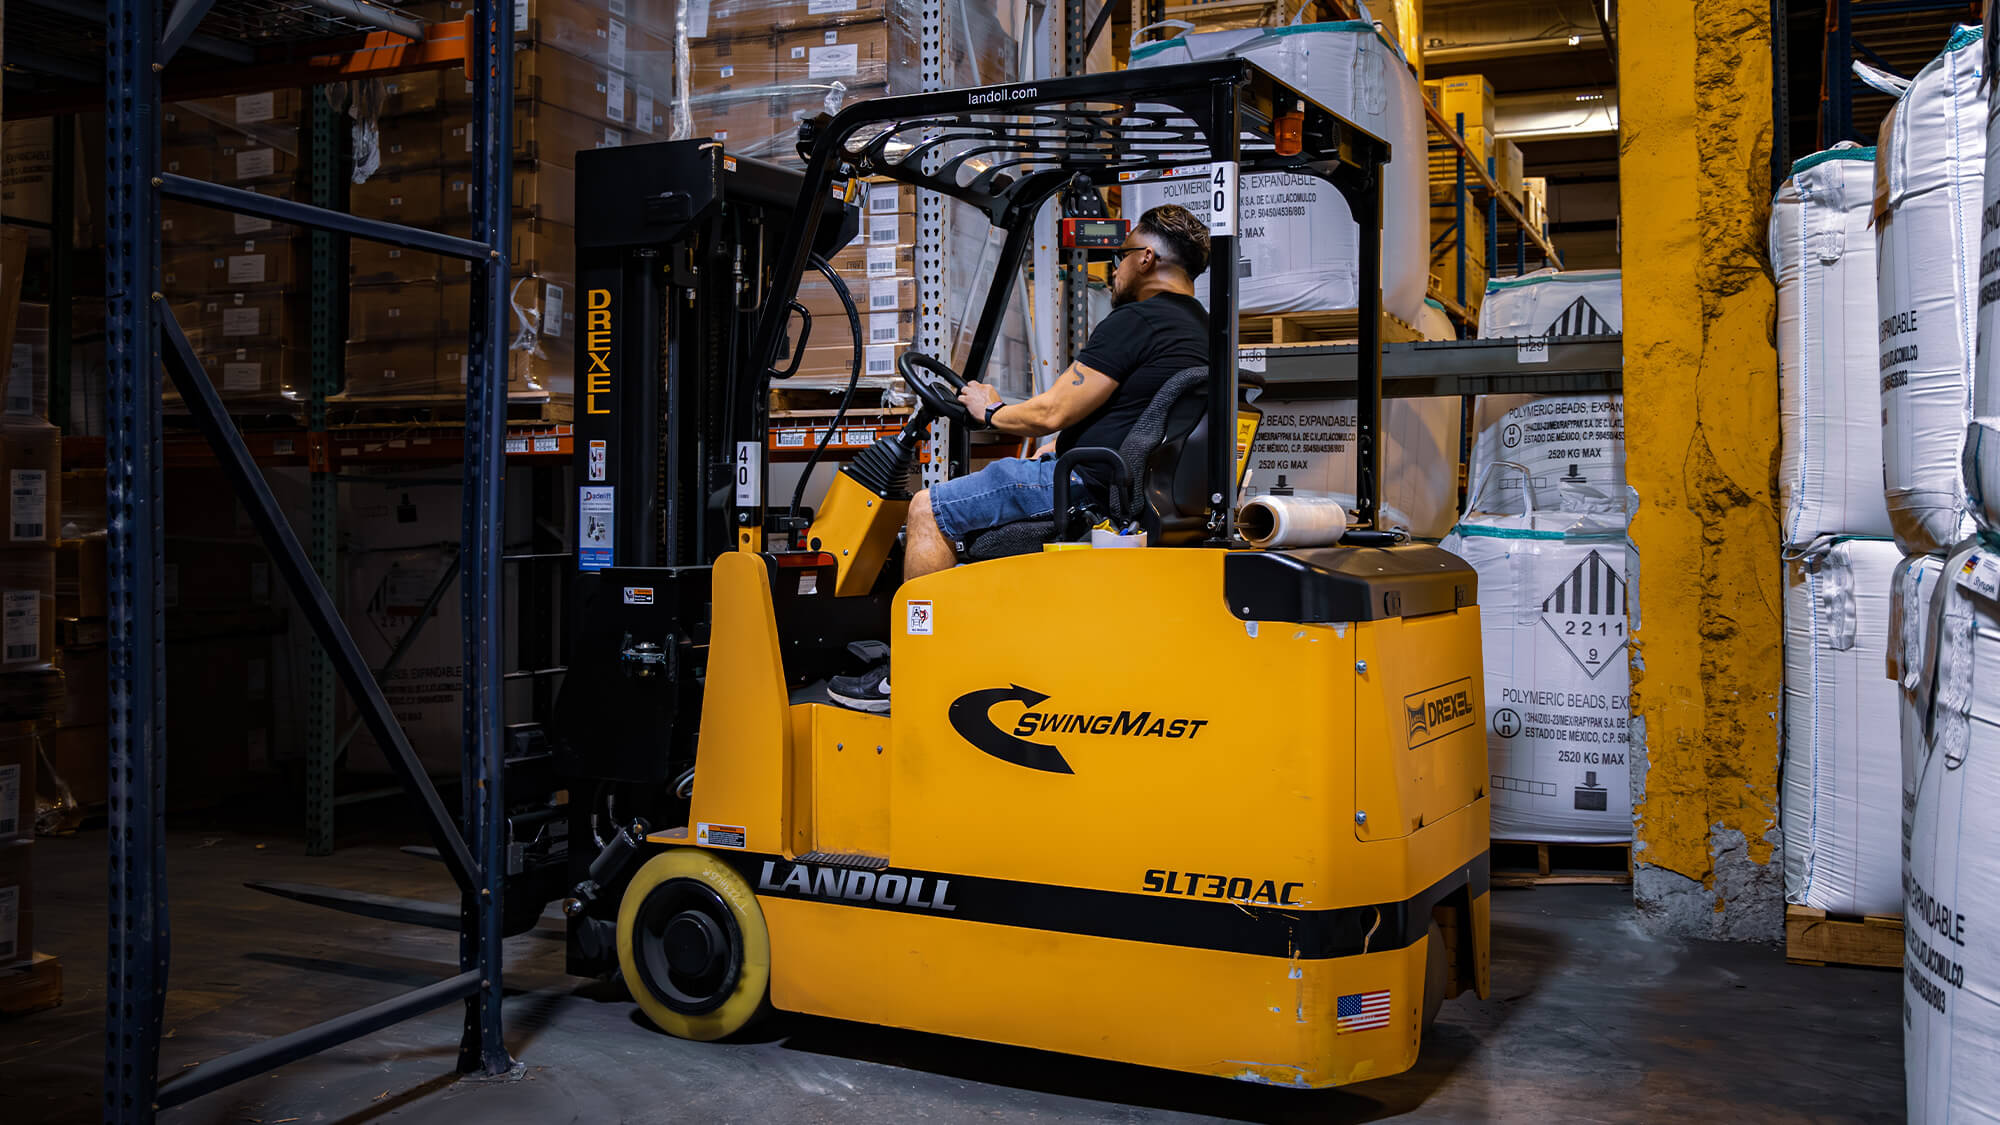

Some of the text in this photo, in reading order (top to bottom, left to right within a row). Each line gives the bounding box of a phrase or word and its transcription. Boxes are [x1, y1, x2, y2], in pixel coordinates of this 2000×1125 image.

[968, 87, 1037, 105] landoll.com
[1251, 174, 1317, 189] EXPANDABLE
[1163, 181, 1211, 198] POLYMERIC
[1256, 195, 1264, 205] DE
[1244, 206, 1306, 219] C.P. 50450/4536/803
[1245, 226, 1265, 238] MAX
[587, 289, 611, 414] DREXEL
[1509, 401, 1623, 419] POLYMERIC BEADS, EXPAN
[1267, 415, 1297, 427] BEADS,
[1299, 415, 1357, 427] EXPANDABLE
[1524, 433, 1546, 444] ESTADO
[1546, 432, 1555, 442] DE
[1257, 444, 1265, 452] DE
[1548, 447, 1601, 459] 2520 KG MAX
[1258, 460, 1308, 469] 2520 KG MAX
[1565, 620, 1623, 637] 2211
[1589, 648, 1598, 660] 9
[1502, 688, 1565, 707] POLYMERIC
[1567, 693, 1609, 711] BEADS,
[1427, 690, 1473, 728] DREXEL
[1604, 718, 1615, 728] S.A.
[1616, 719, 1626, 729] DE
[1525, 727, 1630, 744] ESTADO DE MÉXICO, C.P. 504
[1558, 750, 1625, 765] 2520 KG MAX
[758, 861, 956, 911] LANDOLL
[1142, 869, 1304, 905] SLT30AC
